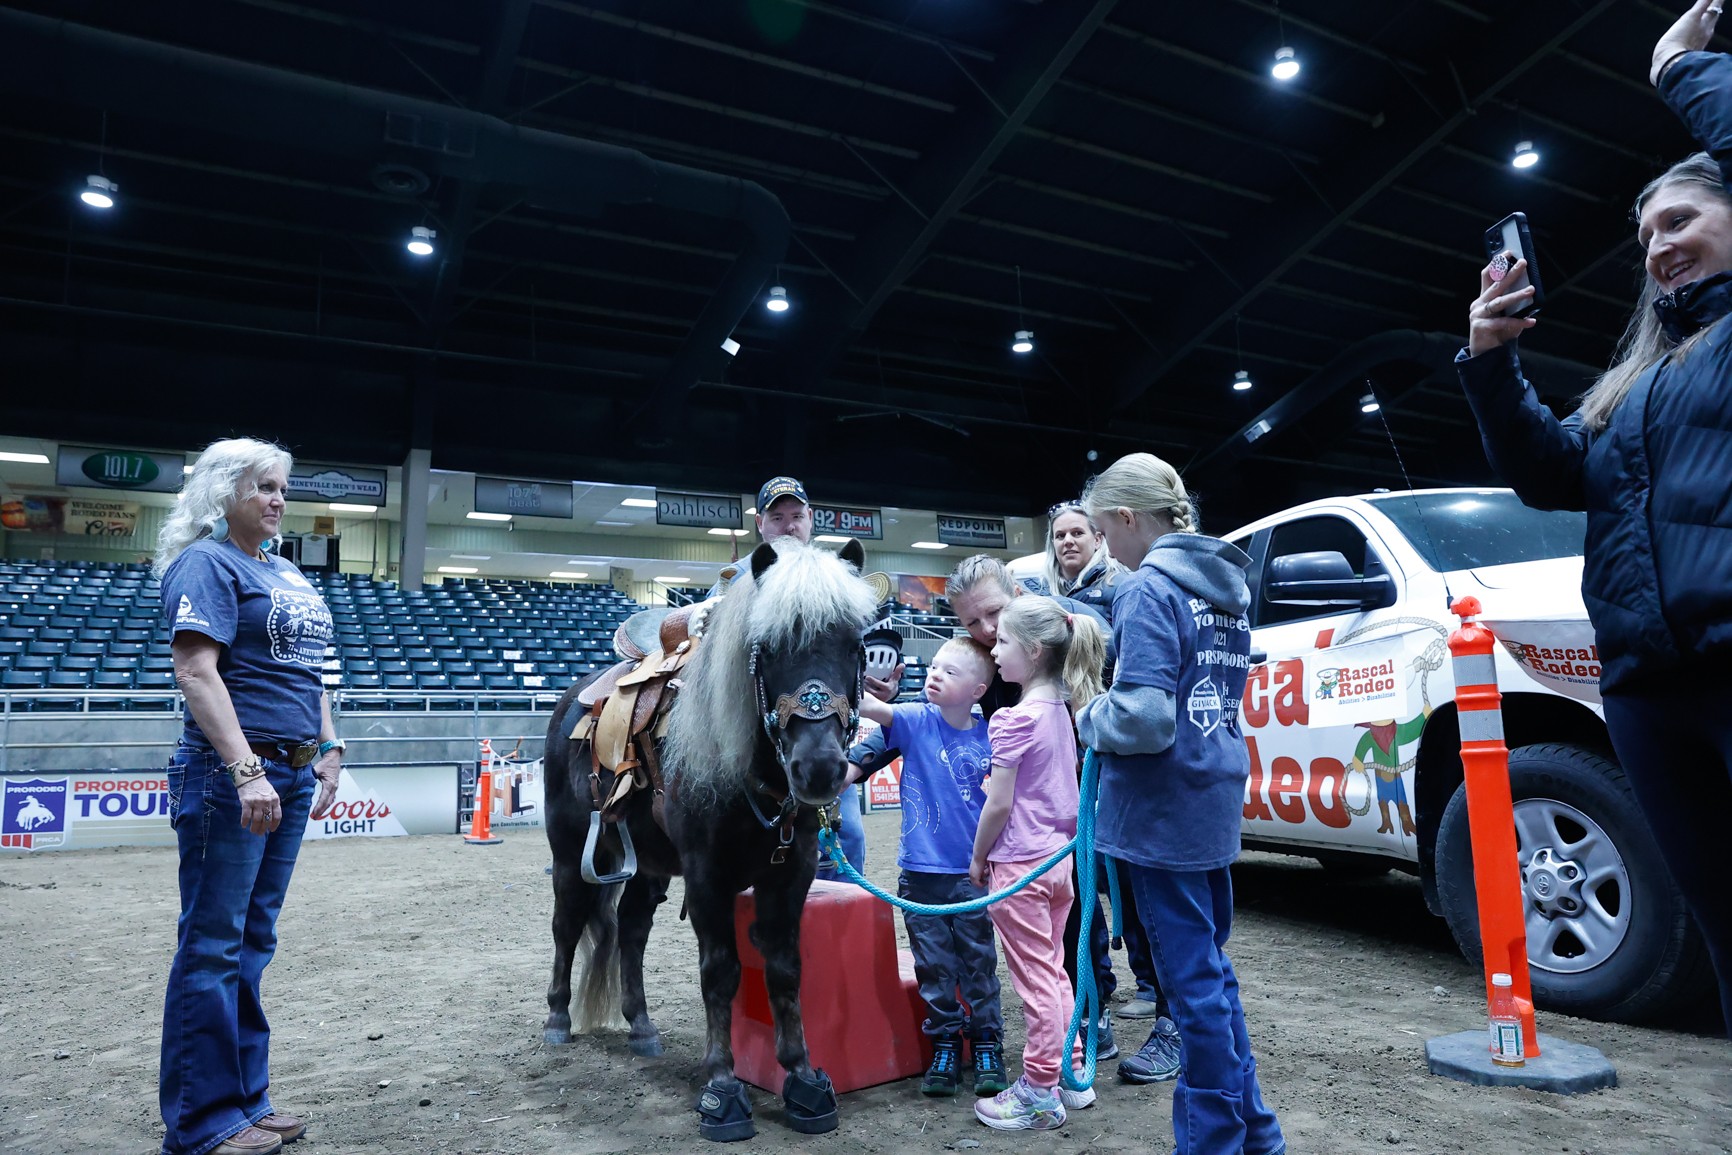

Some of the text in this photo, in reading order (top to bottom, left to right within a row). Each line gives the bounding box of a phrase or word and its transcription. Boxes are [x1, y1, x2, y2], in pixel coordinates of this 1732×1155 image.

[104, 455, 144, 478] 101.7
[72, 501, 125, 511] WELCOME
[659, 496, 740, 519] pahlisch
[71, 509, 136, 519] RODEO FANS
[940, 519, 1003, 532] REDPOINT
[1213, 632, 1227, 646] 021
[1338, 659, 1394, 682] Rascal
[1528, 657, 1602, 677] Rodeo
[1338, 678, 1395, 697] Rodeo
[1366, 691, 1396, 701] Disabilities
[7, 785, 65, 794] PRORODEO
[74, 780, 168, 792] PRORODE
[309, 798, 391, 820] oors
[324, 820, 376, 834] LIGHT
[36, 836, 61, 844] PRCA
